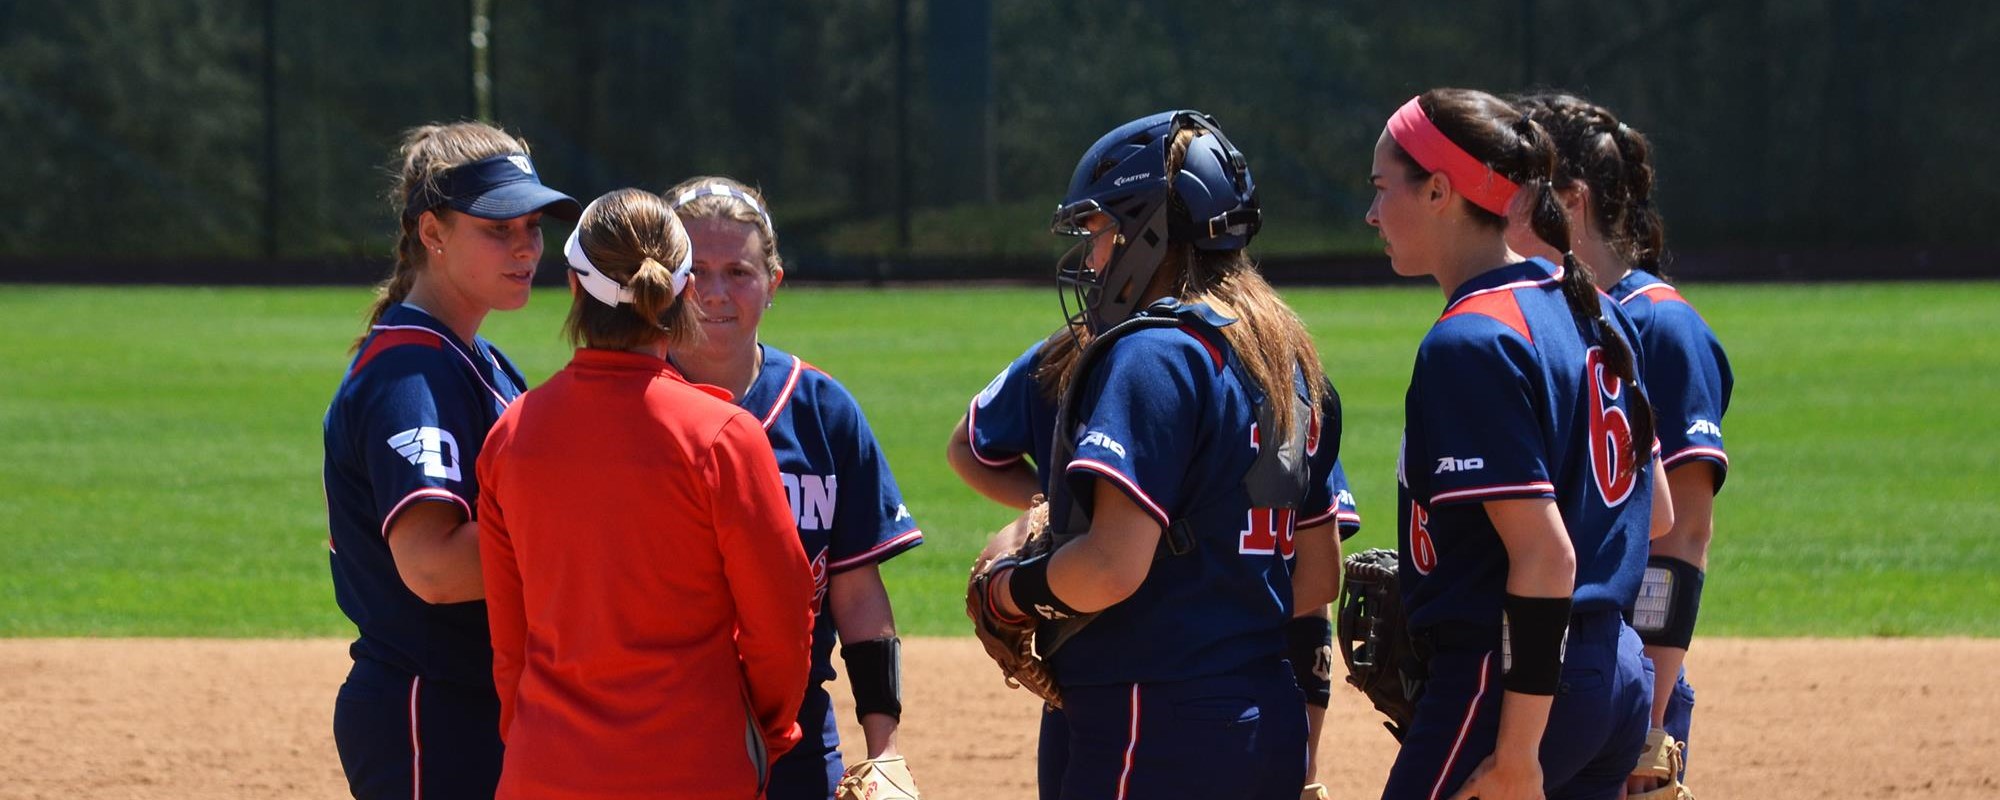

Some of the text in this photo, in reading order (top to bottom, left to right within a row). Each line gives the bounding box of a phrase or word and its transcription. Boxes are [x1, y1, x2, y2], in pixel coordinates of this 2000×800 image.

[1585, 346, 1638, 508] 6
[1686, 419, 1722, 438] A1
[1079, 430, 1126, 460] A10
[1434, 456, 1484, 474] A10
[1409, 499, 1438, 576] 6
